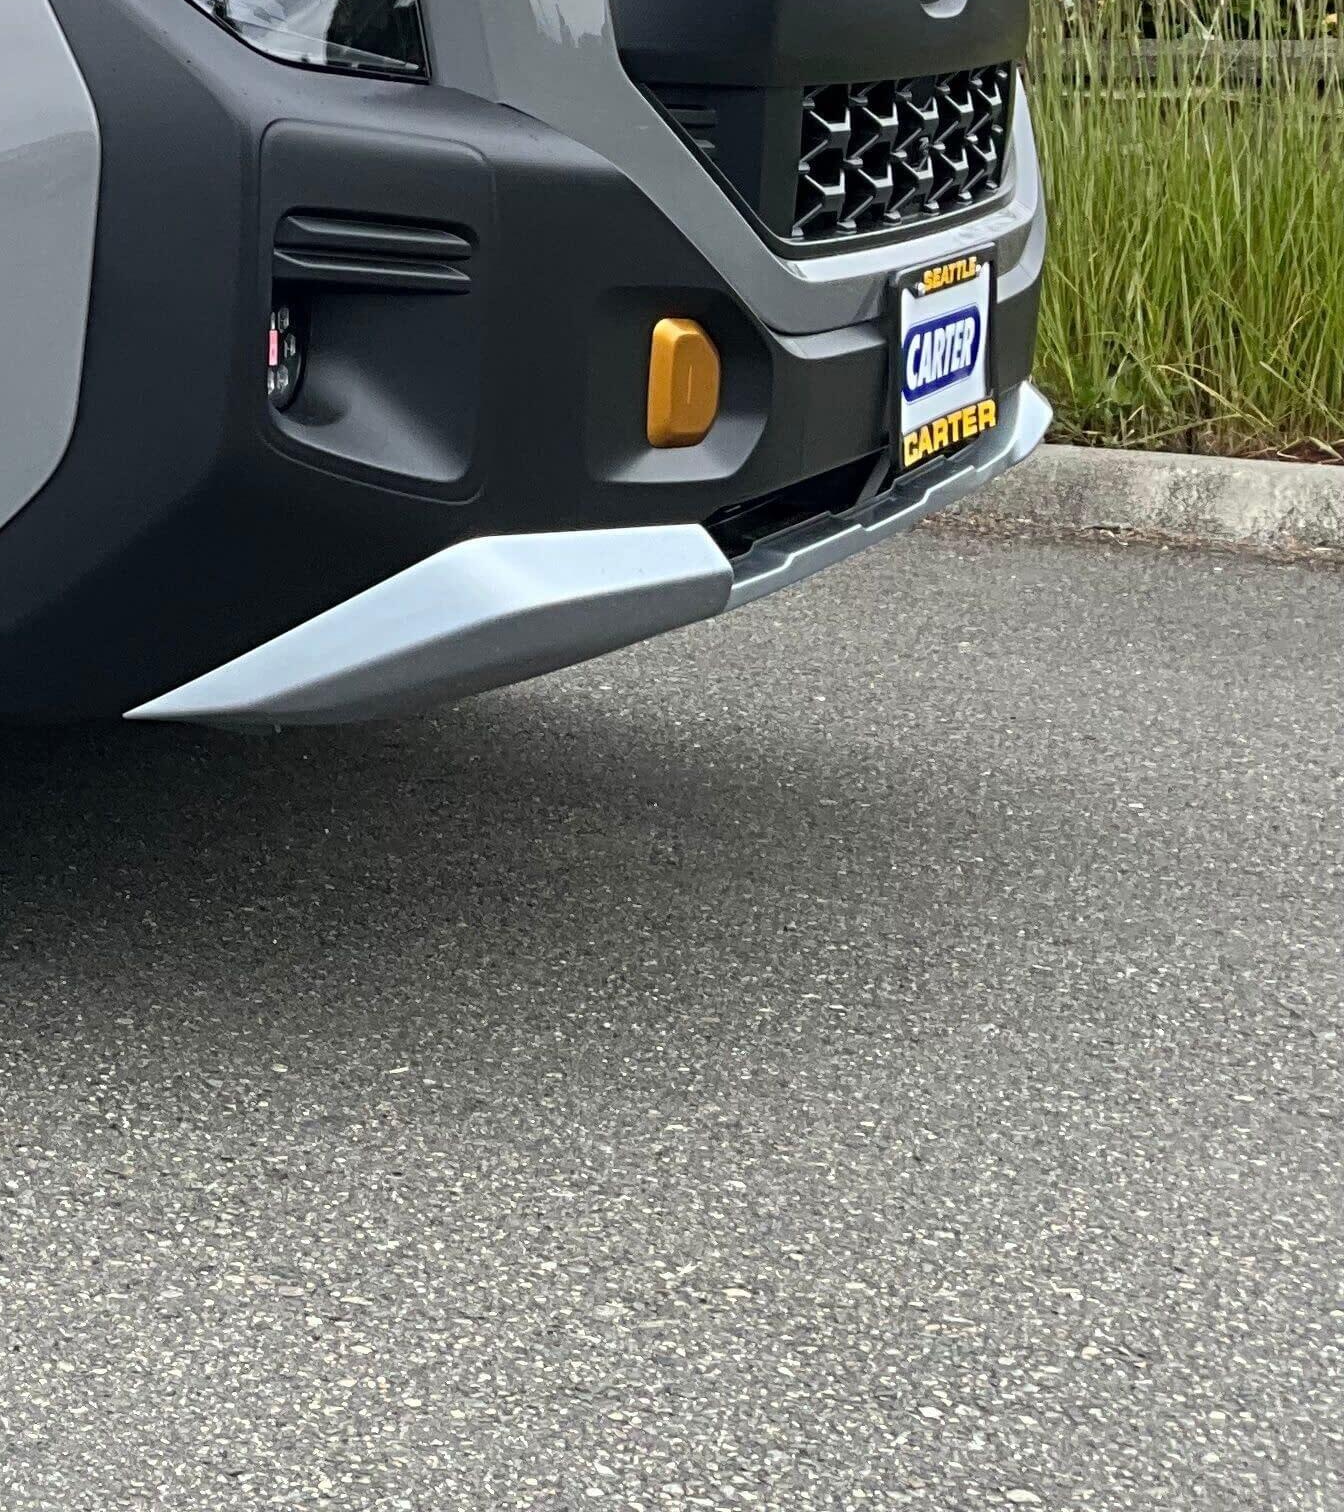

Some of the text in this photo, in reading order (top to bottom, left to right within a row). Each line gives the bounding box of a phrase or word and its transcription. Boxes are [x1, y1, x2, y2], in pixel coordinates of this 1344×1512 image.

[922, 256, 977, 291] SEATTLE
[906, 317, 975, 391] CARTER
[903, 399, 997, 468] CARTER
